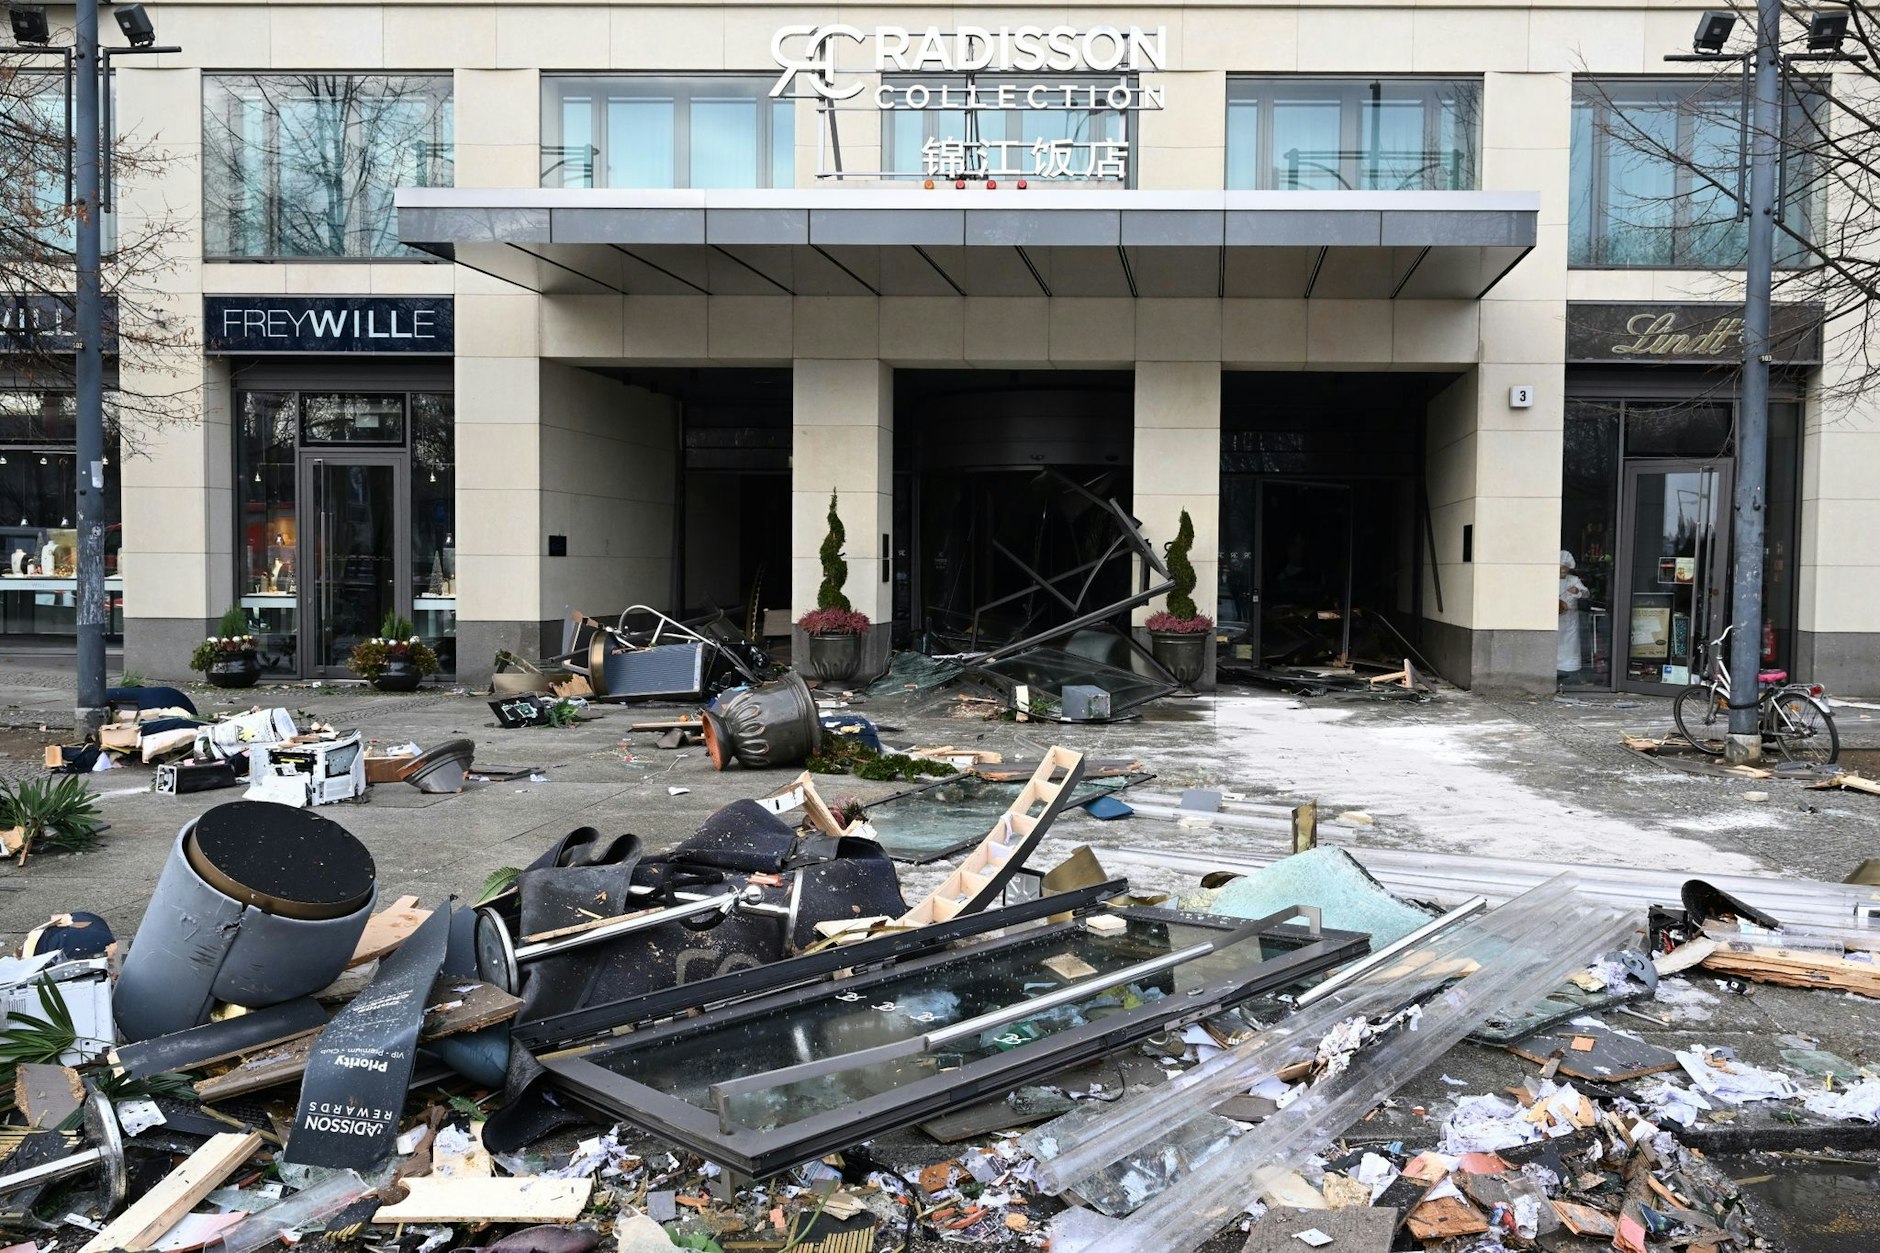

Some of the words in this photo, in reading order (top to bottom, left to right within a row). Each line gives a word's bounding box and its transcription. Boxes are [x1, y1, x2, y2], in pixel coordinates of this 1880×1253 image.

[875, 25, 1167, 72] RADISSON
[874, 84, 1166, 110] COLLECTION
[921, 136, 1129, 179] 锦江饭店
[223, 309, 436, 339] FREYWILLE
[1611, 312, 1742, 355] Lindt
[1519, 390, 1527, 402] 3
[348, 1047, 384, 1056] Premium
[391, 1051, 405, 1059] VIP
[334, 1055, 388, 1072] Priority
[309, 1101, 393, 1120] REWARDS
